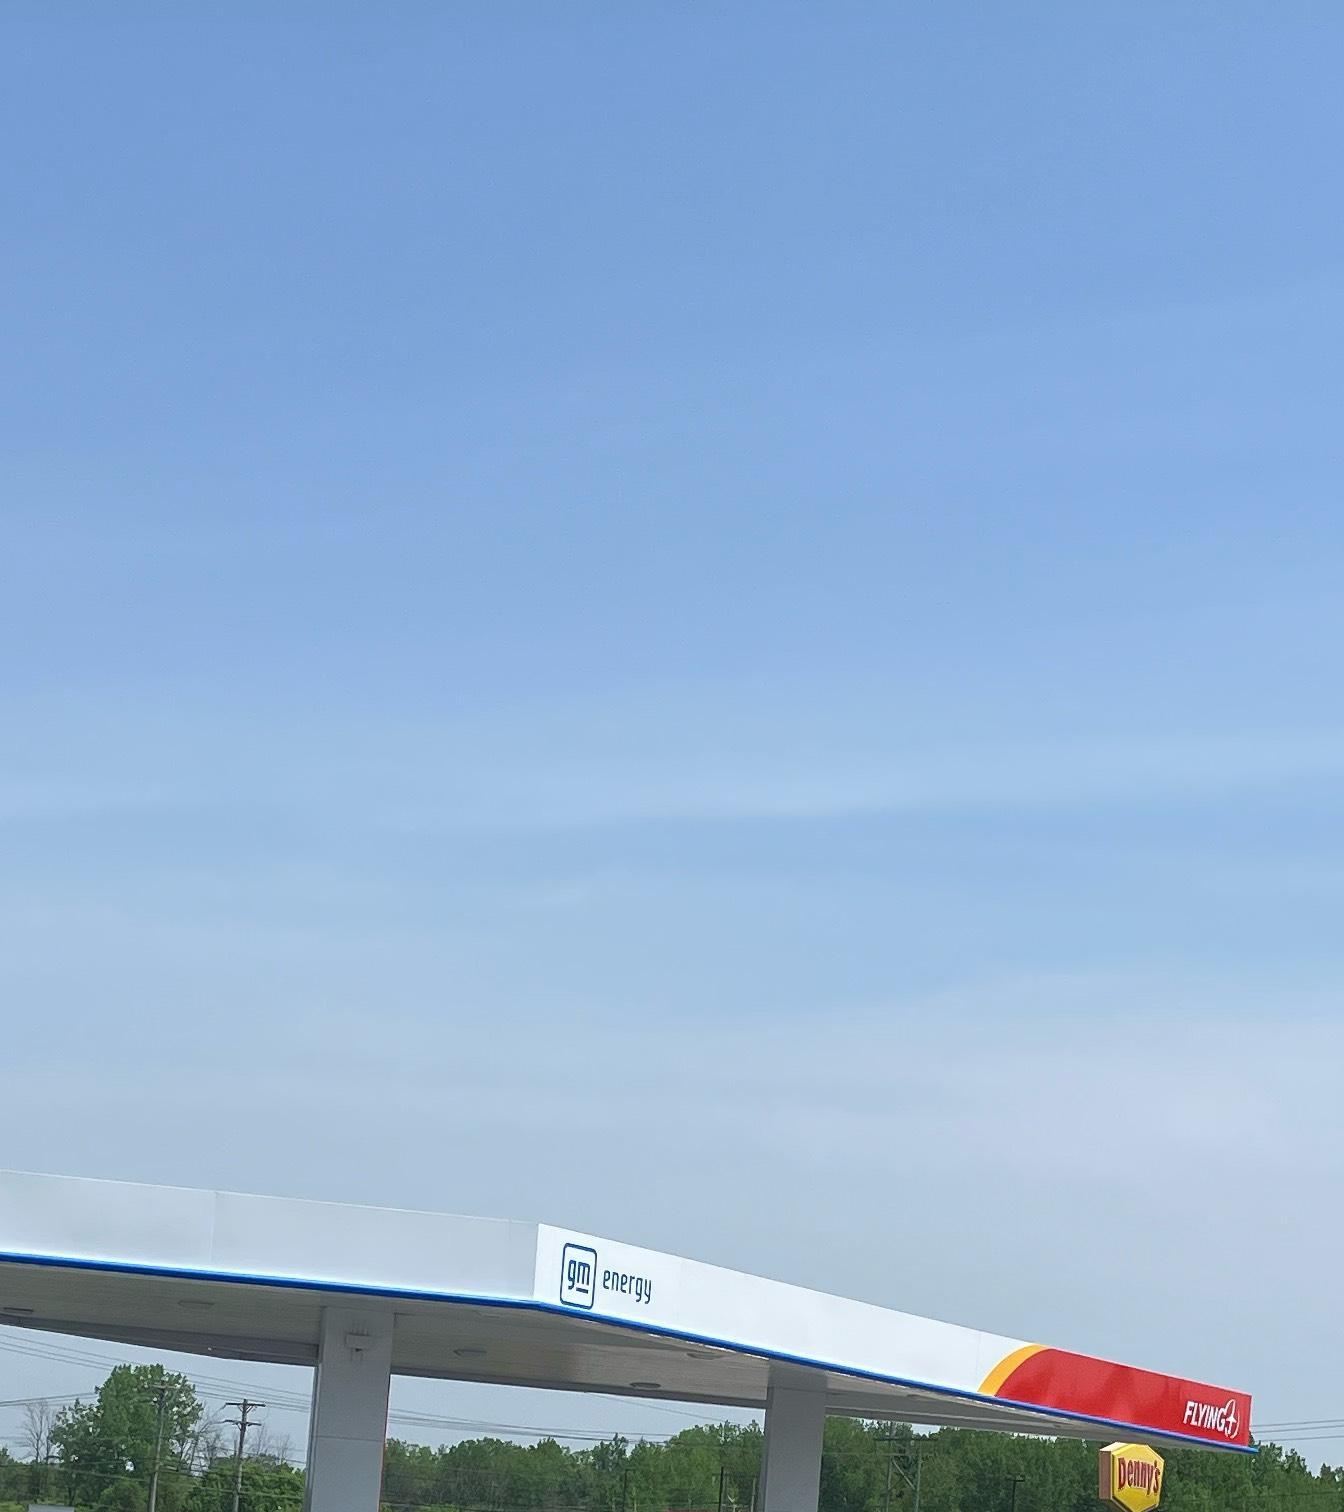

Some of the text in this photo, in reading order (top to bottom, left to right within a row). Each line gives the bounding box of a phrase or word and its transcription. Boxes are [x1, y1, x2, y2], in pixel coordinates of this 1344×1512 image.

[567, 1259, 652, 1305] gm energy
[1183, 1400, 1227, 1432] FLYING
[1117, 1457, 1161, 1496] Denny's
